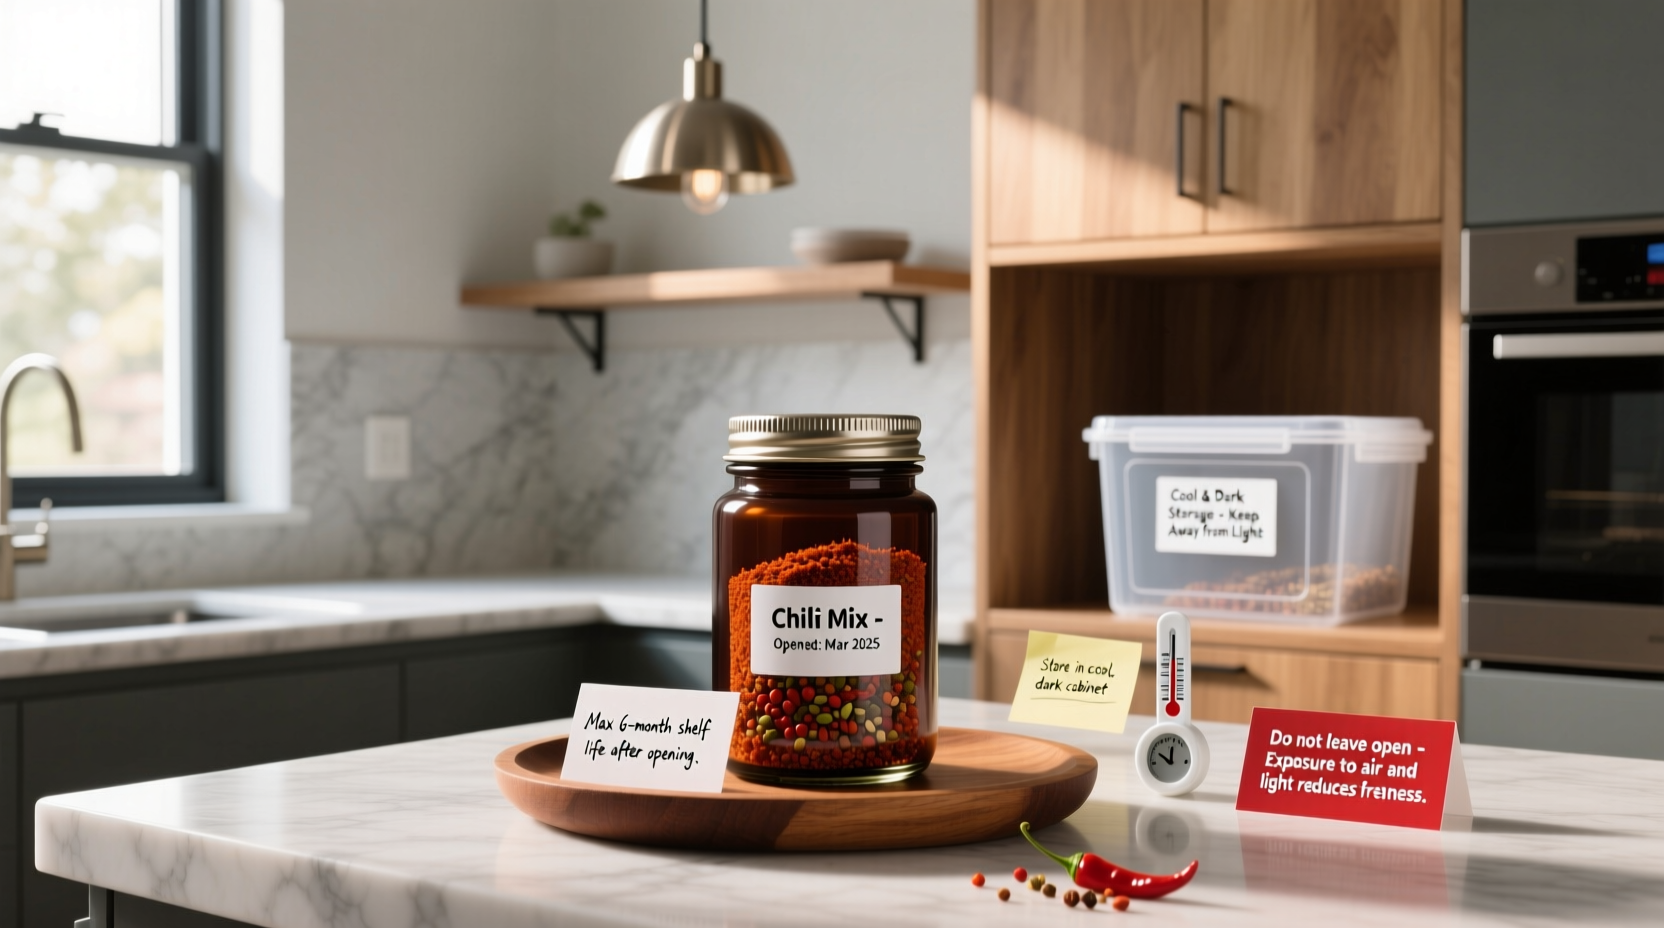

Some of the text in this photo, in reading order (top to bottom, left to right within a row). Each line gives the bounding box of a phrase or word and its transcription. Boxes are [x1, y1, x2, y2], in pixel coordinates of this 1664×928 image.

[1171, 488, 1245, 503] Cool & Dark
[1228, 508, 1259, 523] Keep
[1168, 524, 1199, 539] Away
[1203, 524, 1228, 537] from
[772, 606, 821, 629] Chili
[828, 607, 868, 629] Mix
[773, 637, 880, 654] Opened: Mar 2025
[1040, 658, 1070, 673] Store
[1075, 661, 1084, 673] in
[1035, 676, 1108, 695] dark cabinet
[584, 711, 712, 741] Max 6-month shelf
[1270, 729, 1293, 746] Do
[1296, 734, 1323, 749] not
[1326, 733, 1367, 752] leave
[1371, 739, 1411, 758] open
[584, 739, 699, 770] life after opening.
[1265, 751, 1418, 779] Exposure to air and
[1260, 772, 1294, 794] light
[1297, 777, 1357, 798] reduces
